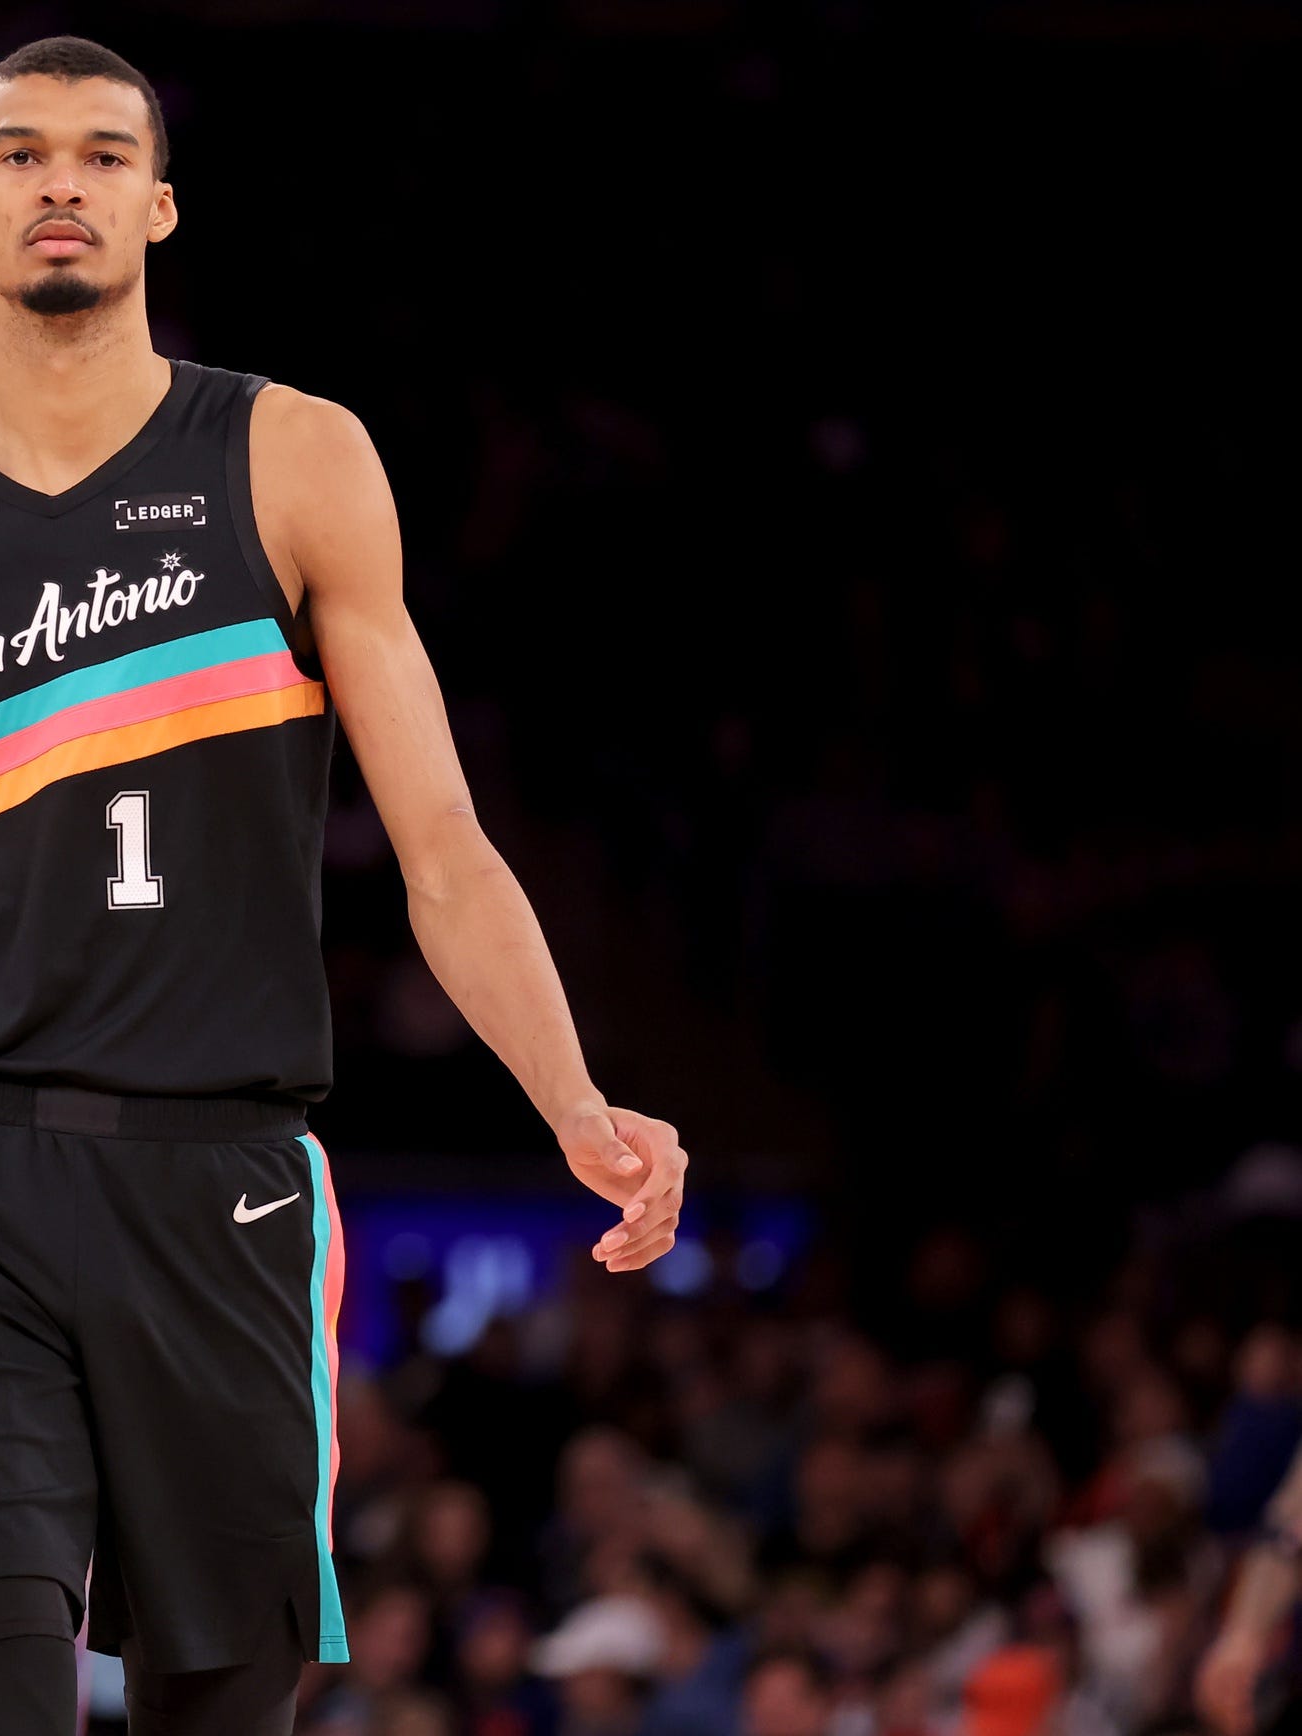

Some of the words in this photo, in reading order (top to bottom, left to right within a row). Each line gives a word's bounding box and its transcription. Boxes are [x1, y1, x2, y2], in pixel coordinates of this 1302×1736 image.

[126, 504, 194, 521] LEDGER
[10, 567, 205, 666] Antonio
[105, 790, 165, 910] 1
